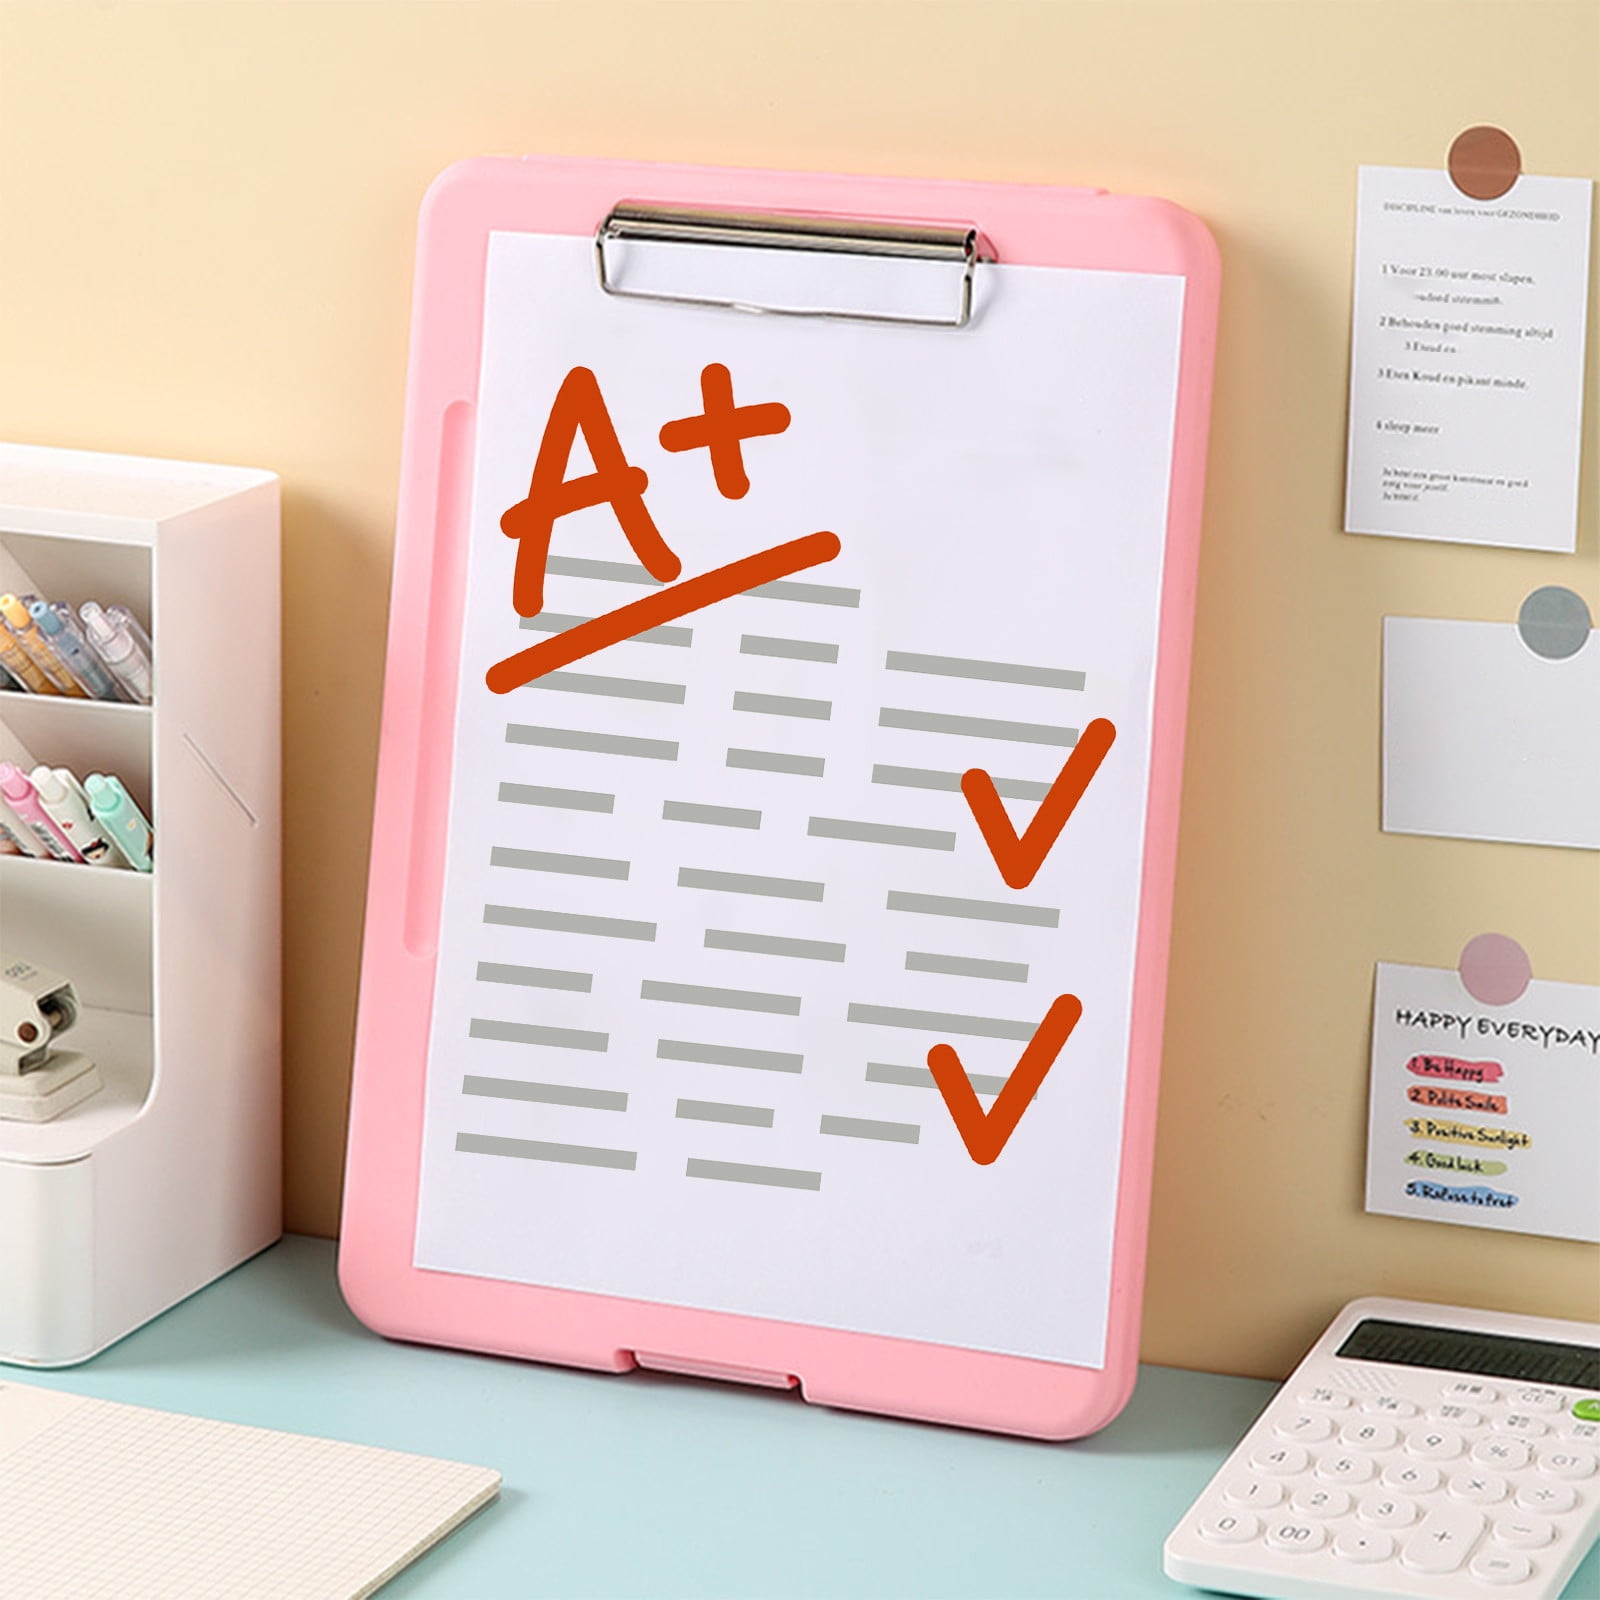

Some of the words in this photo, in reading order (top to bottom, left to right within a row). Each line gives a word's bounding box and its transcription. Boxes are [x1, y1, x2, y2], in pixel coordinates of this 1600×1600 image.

[1390, 264, 1417, 276] Voor
[1379, 316, 1387, 327] 2
[1388, 317, 1440, 330] Behouden
[500, 363, 791, 618] A+
[1396, 1009, 1472, 1040] HAPPY
[1477, 1018, 1600, 1054] EVERYDAY
[1444, 1058, 1484, 1083] Happy
[1477, 1127, 1529, 1150] Sunlight
[1296, 1418, 1311, 1429] 7
[1360, 1427, 1375, 1439] 8
[1426, 1435, 1442, 1447] 9
[1269, 1451, 1286, 1462] 4
[1552, 1454, 1579, 1466] GT
[1336, 1459, 1352, 1471] 5
[1402, 1470, 1417, 1481] 6
[1249, 1484, 1258, 1495] 1
[1311, 1492, 1328, 1505] 2
[1378, 1502, 1394, 1515] 3
[1218, 1517, 1237, 1530] 0
[1279, 1525, 1311, 1540] 00
